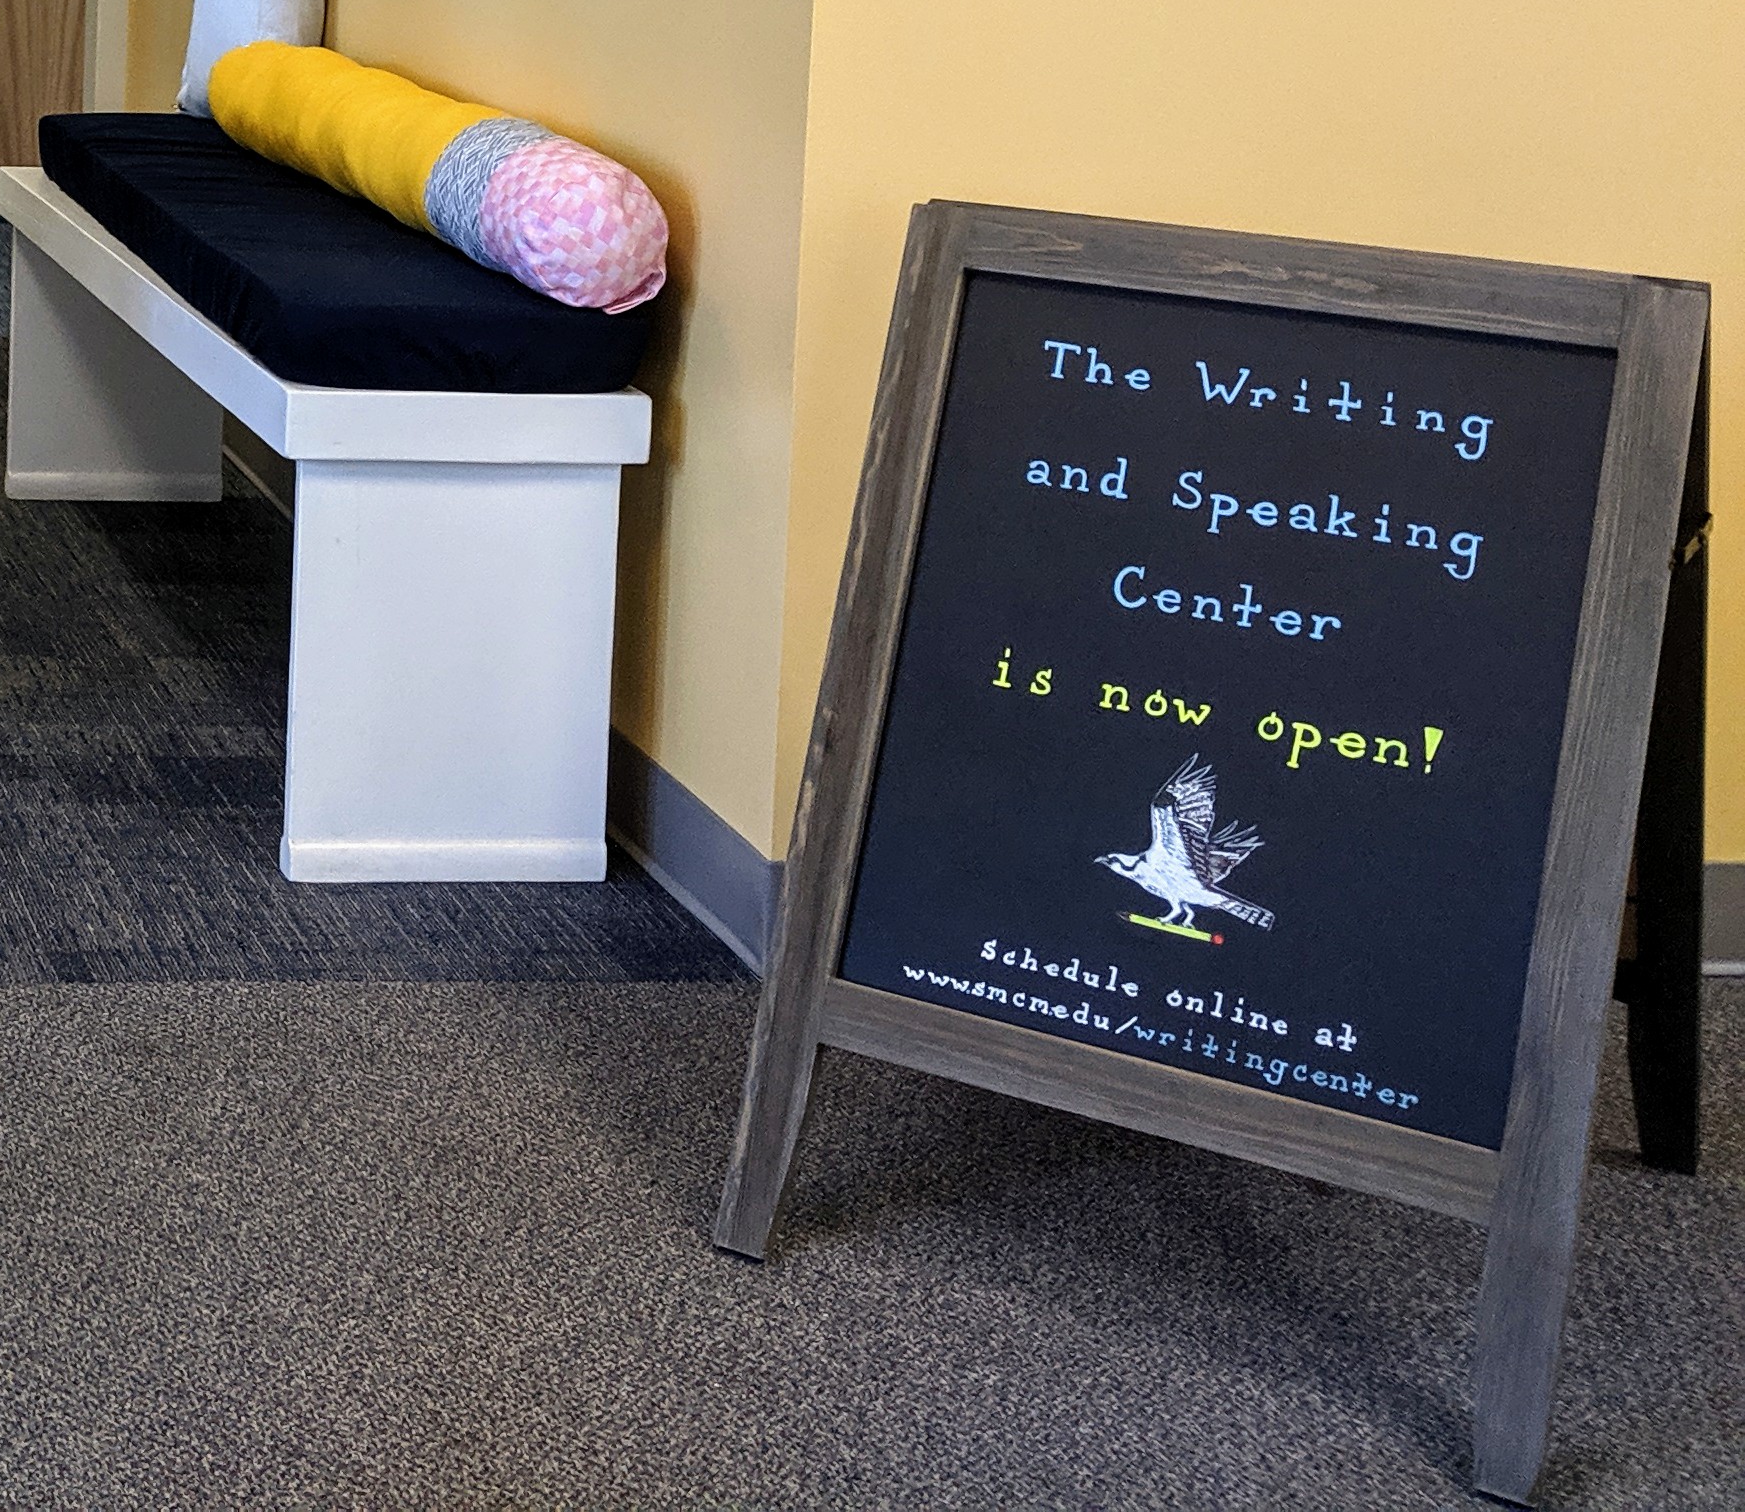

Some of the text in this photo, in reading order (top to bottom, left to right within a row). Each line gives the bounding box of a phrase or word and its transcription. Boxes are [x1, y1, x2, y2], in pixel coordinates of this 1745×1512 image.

[1044, 340, 1494, 461] The Writing
[1026, 457, 1484, 580] and Speaking
[1113, 565, 1342, 641] Center
[992, 647, 1444, 774] is now open!
[980, 939, 1358, 1052] Schedule online at
